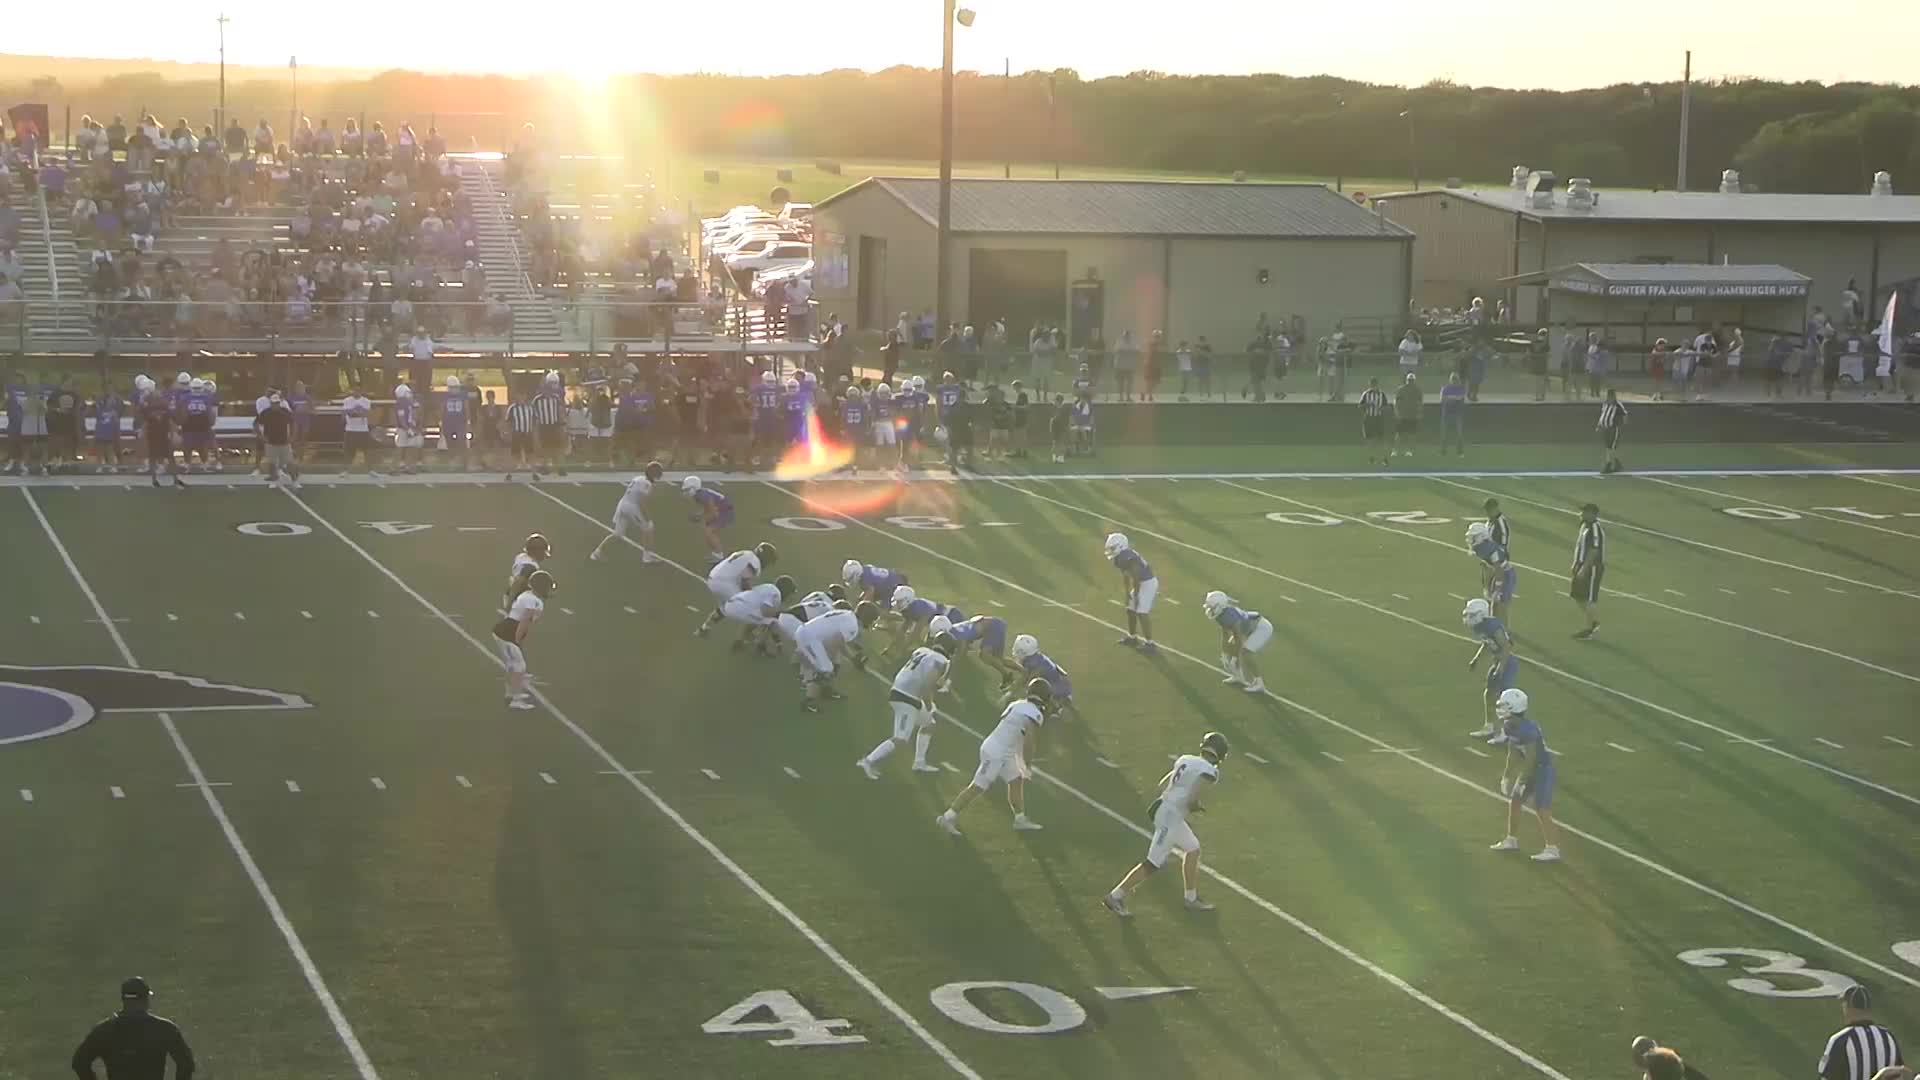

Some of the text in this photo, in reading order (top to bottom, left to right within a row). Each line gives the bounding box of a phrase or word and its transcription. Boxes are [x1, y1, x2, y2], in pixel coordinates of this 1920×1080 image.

[1609, 285, 1646, 295] GUNTER
[1648, 285, 1667, 295] FFA
[1667, 285, 1706, 295] ALUMNI
[1717, 285, 1776, 295] HAMBURGER
